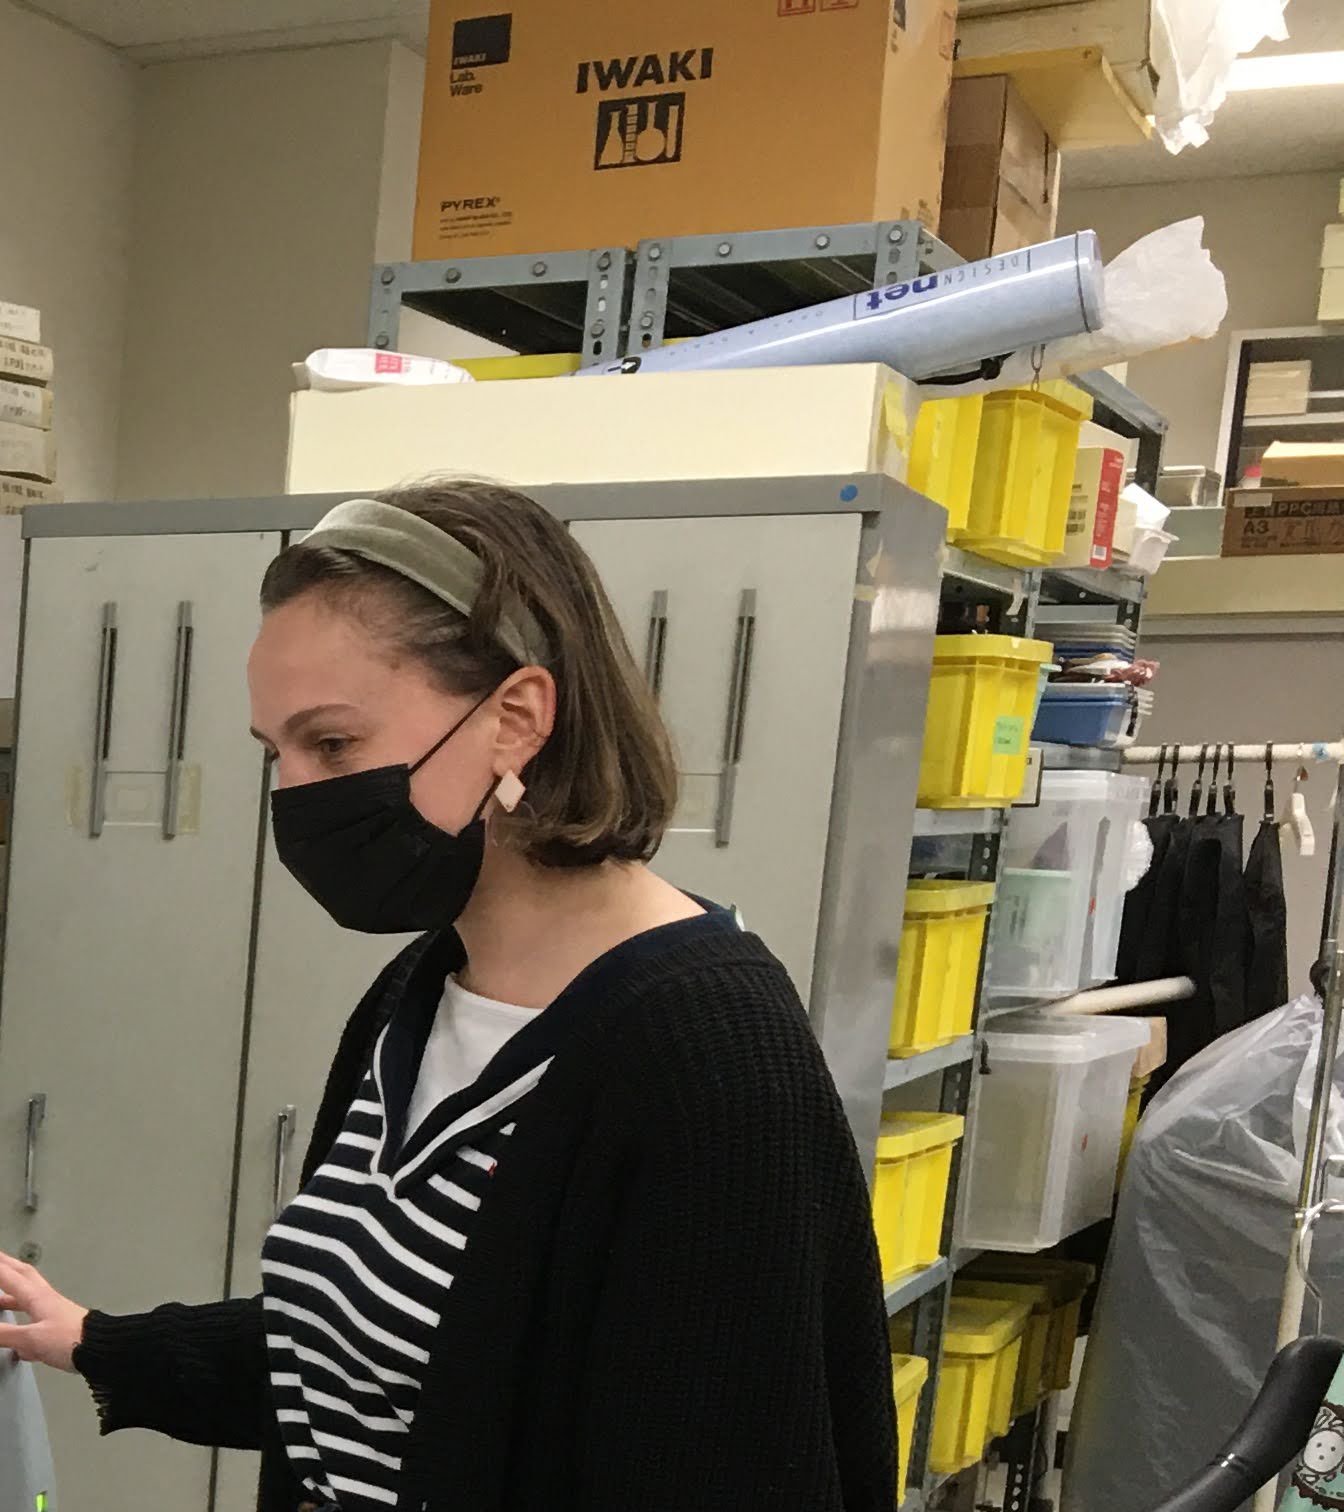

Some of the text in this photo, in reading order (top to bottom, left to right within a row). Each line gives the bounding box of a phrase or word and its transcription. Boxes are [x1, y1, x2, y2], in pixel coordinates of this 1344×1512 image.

[452, 52, 487, 65] IWAKI
[576, 47, 714, 94] IWAKI
[449, 83, 483, 97] Ware
[865, 255, 1019, 311] DESIGN net
[1243, 520, 1270, 535] A3
